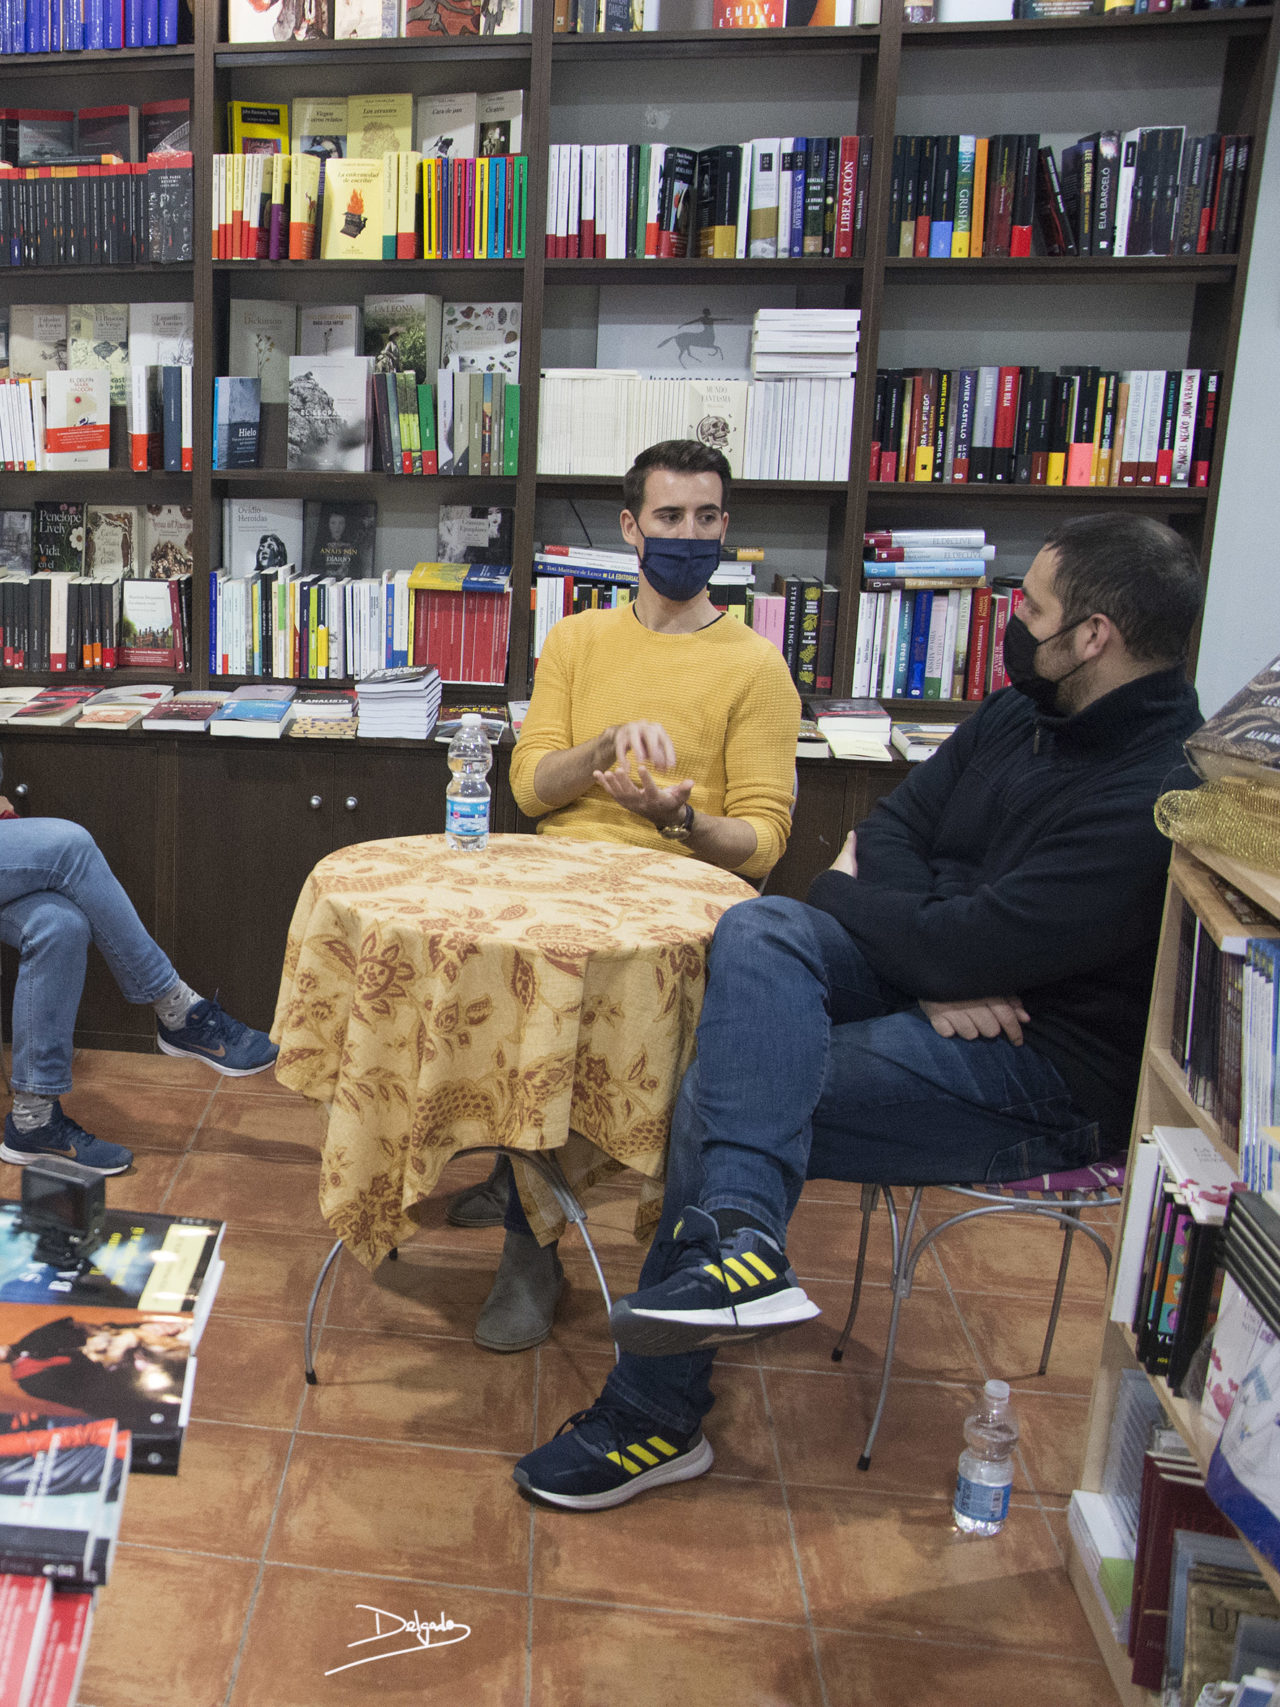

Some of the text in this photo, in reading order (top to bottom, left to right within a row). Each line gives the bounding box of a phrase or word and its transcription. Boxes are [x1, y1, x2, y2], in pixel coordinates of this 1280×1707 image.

[607, 4, 629, 19] DANIELS
[726, 3, 769, 18] EMILY
[719, 12, 776, 27] ETERNA
[840, 161, 854, 232] LIBERACIÓN
[1098, 167, 1111, 230] ELIA BARCELÓ
[957, 188, 970, 233] GRISHA
[387, 304, 415, 313] LEONA
[243, 316, 282, 325] Dickinson
[940, 374, 948, 397] MUERTE
[1002, 375, 1013, 407] REINA ROJA
[922, 394, 931, 421] FUEGO
[940, 397, 946, 406] EN
[960, 375, 972, 439] JAVIER CASTILLO
[939, 406, 945, 414] EL
[1181, 401, 1193, 418] JOHN
[238, 428, 257, 437] Hielo
[1178, 421, 1190, 443] NEGRO
[39, 510, 82, 525] Penelope
[238, 506, 261, 514] Ovidio
[238, 514, 268, 522] Heroidas
[39, 522, 67, 536] Lively
[38, 544, 60, 556] Vida
[787, 586, 797, 645] STEPHEN KING
[899, 642, 907, 661] eres
[927, 652, 935, 674] MISSY
[1245, 730, 1270, 742] ALAN
